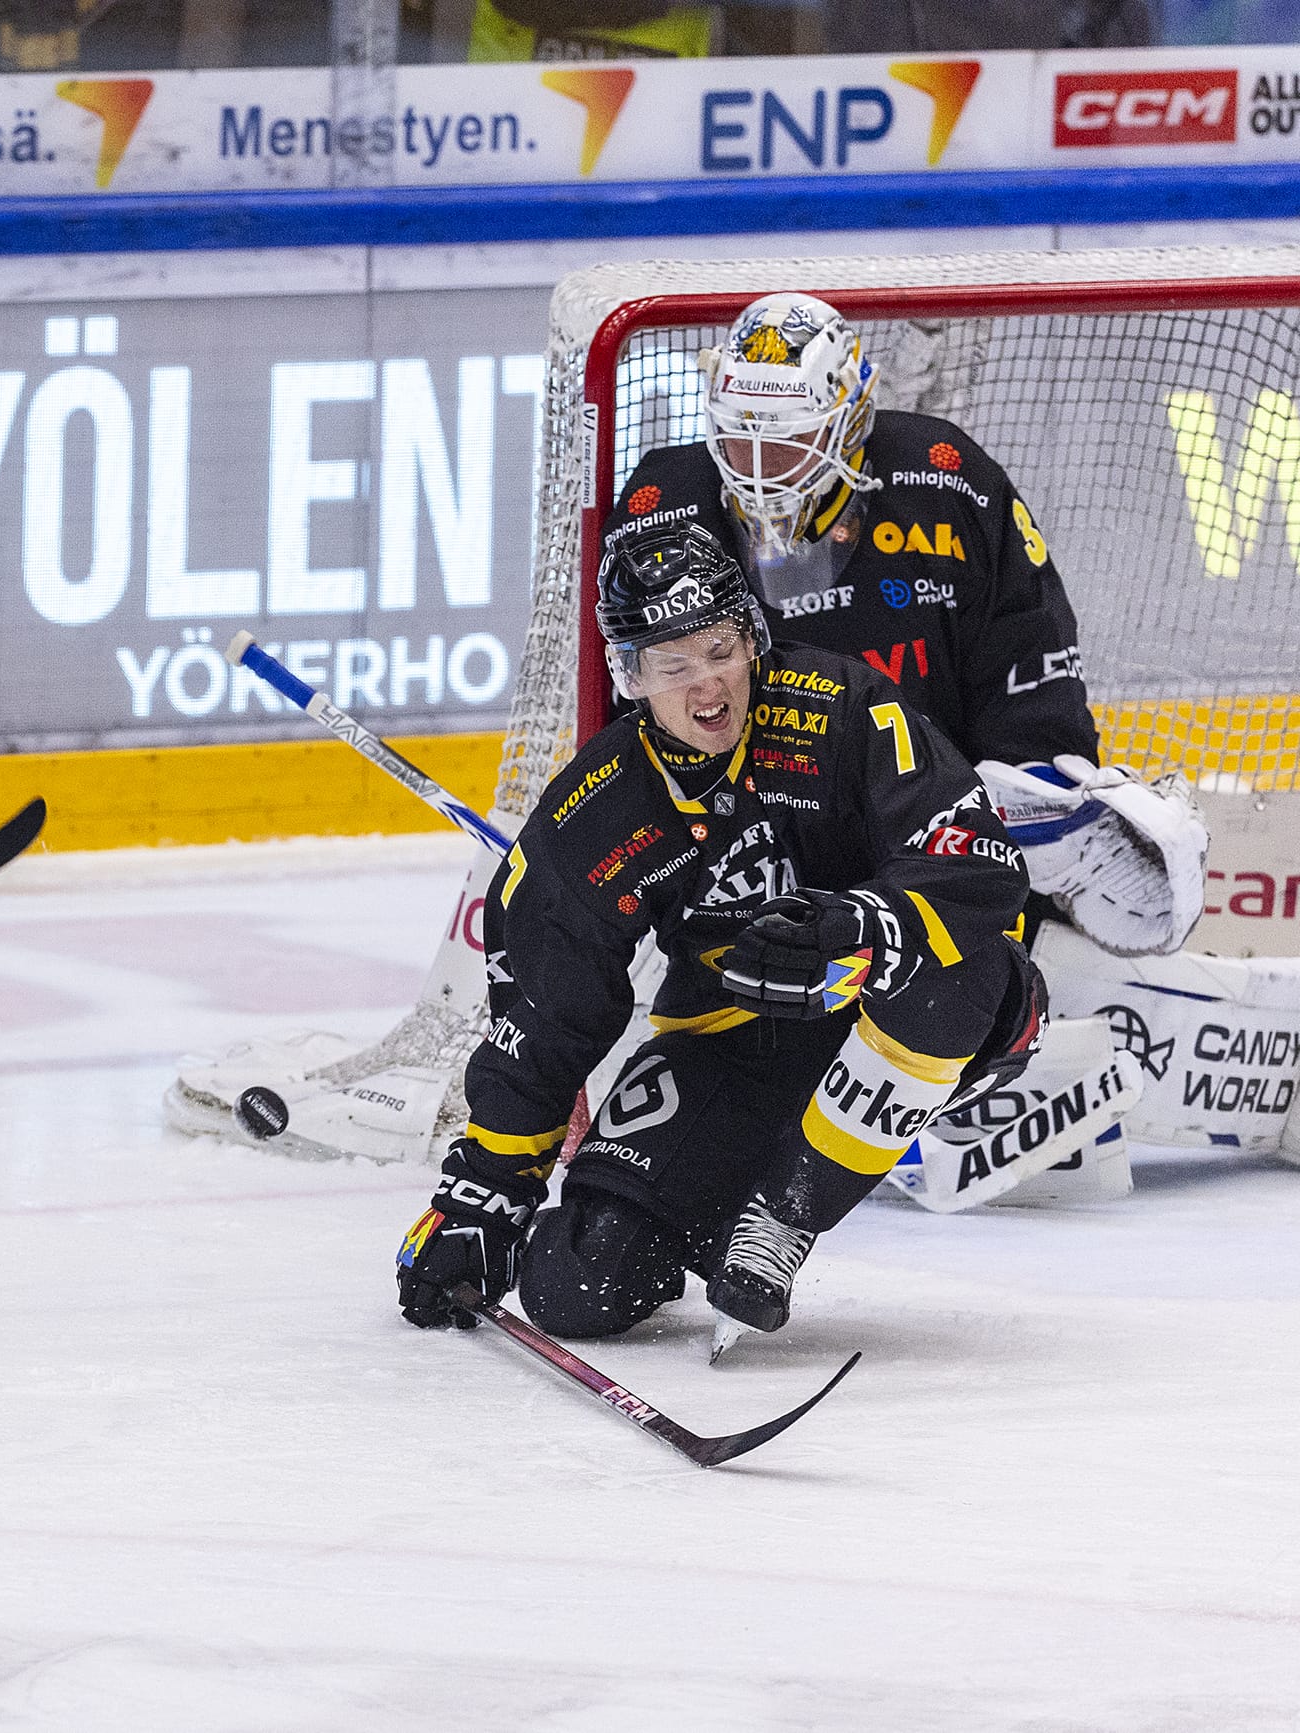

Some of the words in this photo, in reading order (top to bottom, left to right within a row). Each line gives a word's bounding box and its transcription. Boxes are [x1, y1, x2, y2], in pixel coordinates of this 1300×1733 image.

[702, 86, 894, 172] ENP
[1062, 87, 1231, 131] CCM
[761, 381, 808, 393] HINAUS
[604, 504, 699, 549] Pihlajalinna
[654, 552, 664, 563] 7
[642, 585, 715, 625] DISAS
[781, 585, 855, 620] KOFF
[767, 669, 845, 698] worker
[868, 701, 917, 776] 7
[552, 754, 620, 822] worker
[500, 842, 528, 911] 7
[353, 1087, 407, 1112] ICEPRO
[824, 1055, 940, 1138] orker
[1183, 1069, 1294, 1115] WORLD
[956, 1064, 1124, 1194] ACON.fi
[602, 1385, 659, 1425] CCM
